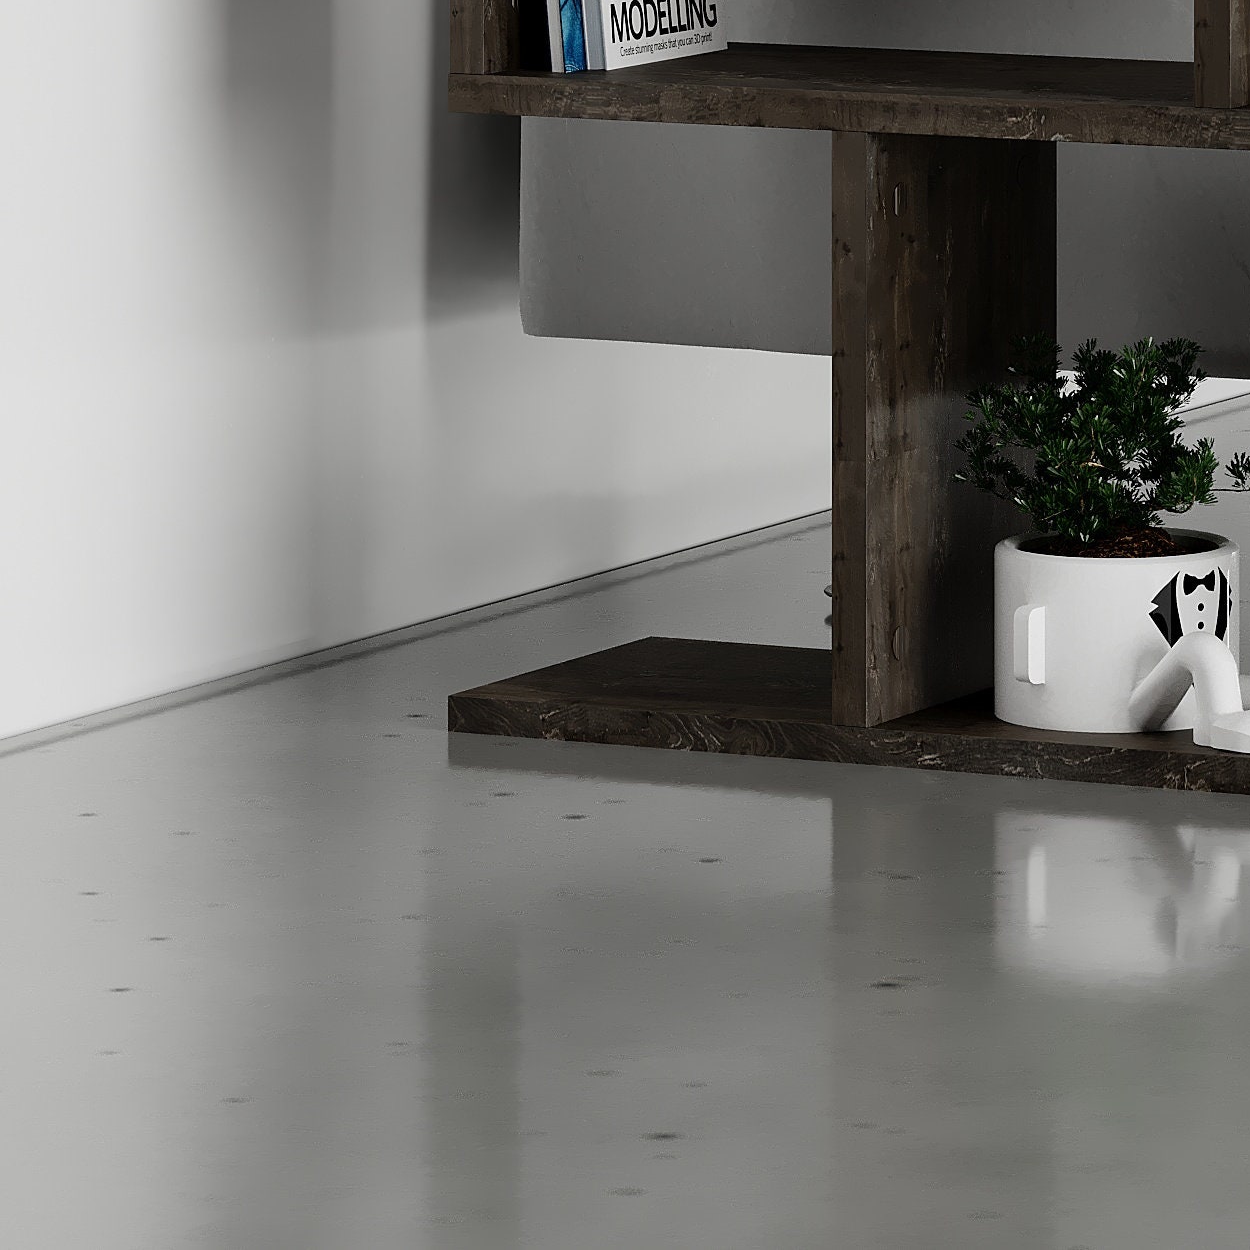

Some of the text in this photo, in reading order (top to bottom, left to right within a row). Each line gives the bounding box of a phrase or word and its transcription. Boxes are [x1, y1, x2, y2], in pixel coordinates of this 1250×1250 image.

[620, 46, 635, 57] Create
[635, 41, 654, 54] stunning
[654, 39, 668, 51] masks
[667, 38, 677, 49] that
[677, 38, 686, 49] you
[685, 37, 694, 47] can
